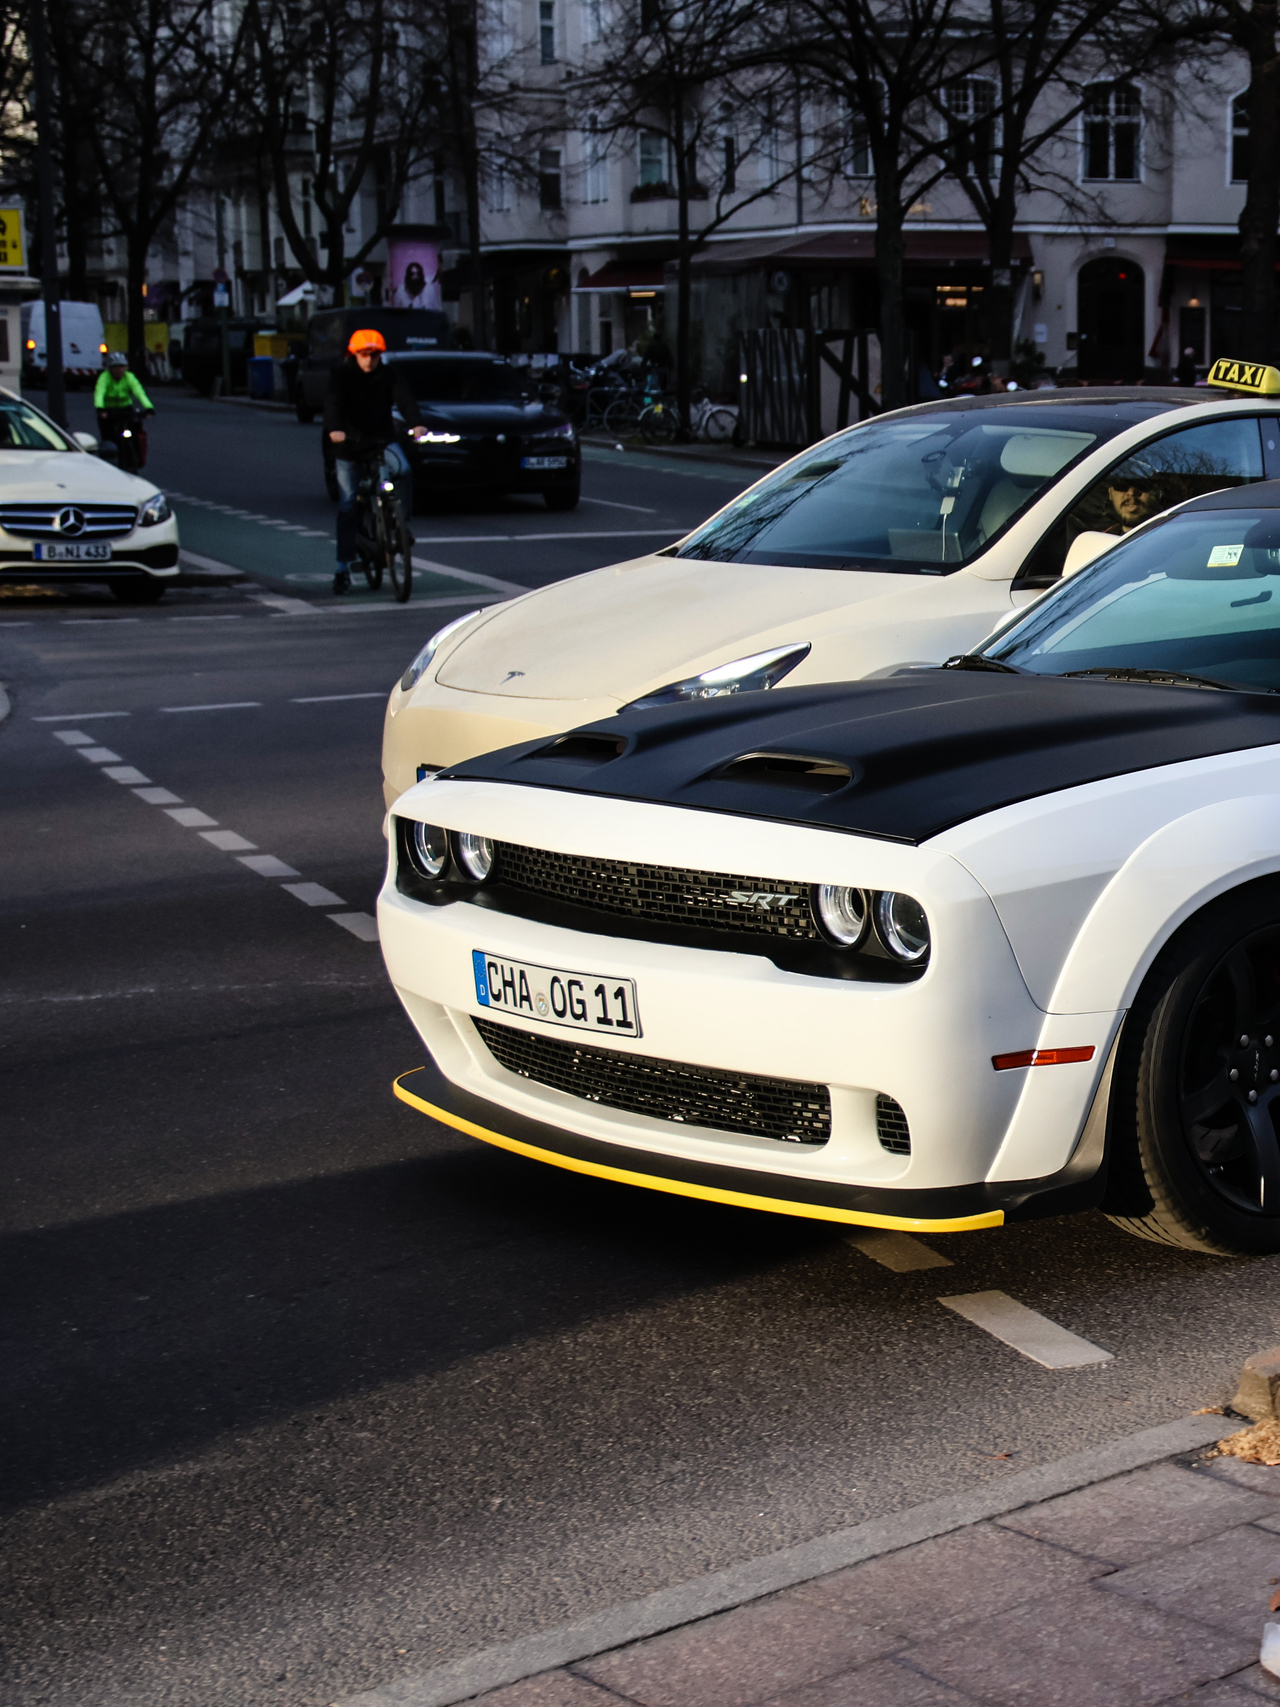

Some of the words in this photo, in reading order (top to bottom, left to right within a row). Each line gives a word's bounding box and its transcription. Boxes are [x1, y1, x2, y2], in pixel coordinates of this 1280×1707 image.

[1218, 361, 1264, 386] TAXI
[47, 546, 56, 558] B
[85, 545, 107, 558] 433
[725, 891, 799, 910] SRT
[480, 984, 485, 996] D
[487, 961, 533, 1012] CHA
[551, 975, 588, 1022] OG
[594, 983, 633, 1029] 11
